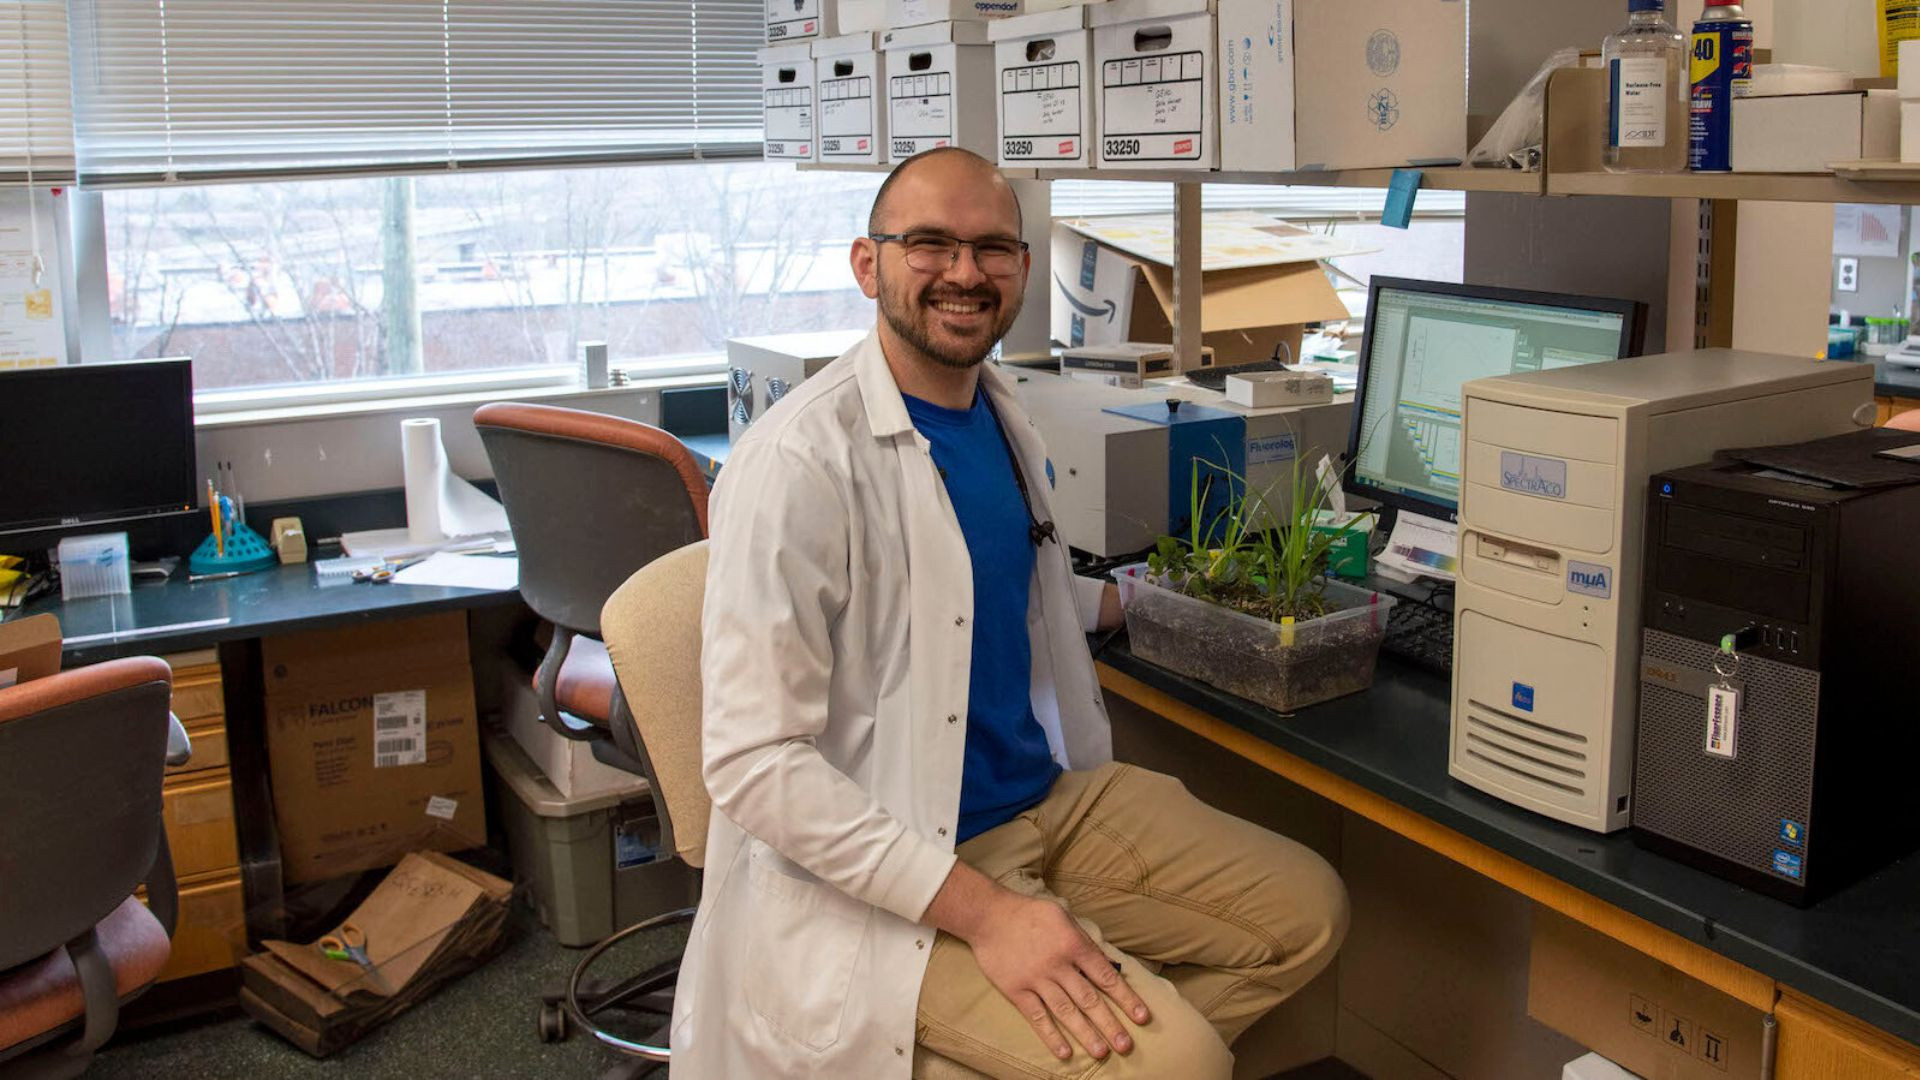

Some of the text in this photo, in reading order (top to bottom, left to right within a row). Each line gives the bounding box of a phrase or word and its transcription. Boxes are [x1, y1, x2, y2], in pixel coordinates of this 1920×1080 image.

[974, 2, 1018, 12] eppendorf
[1227, 39, 1236, 124] www.gbo.com
[823, 139, 841, 151] 33250
[893, 140, 916, 154] 33250
[1005, 140, 1033, 155] 33250
[1105, 139, 1140, 156] 33250
[61, 517, 80, 525] DELL
[309, 695, 374, 718] FALCON
